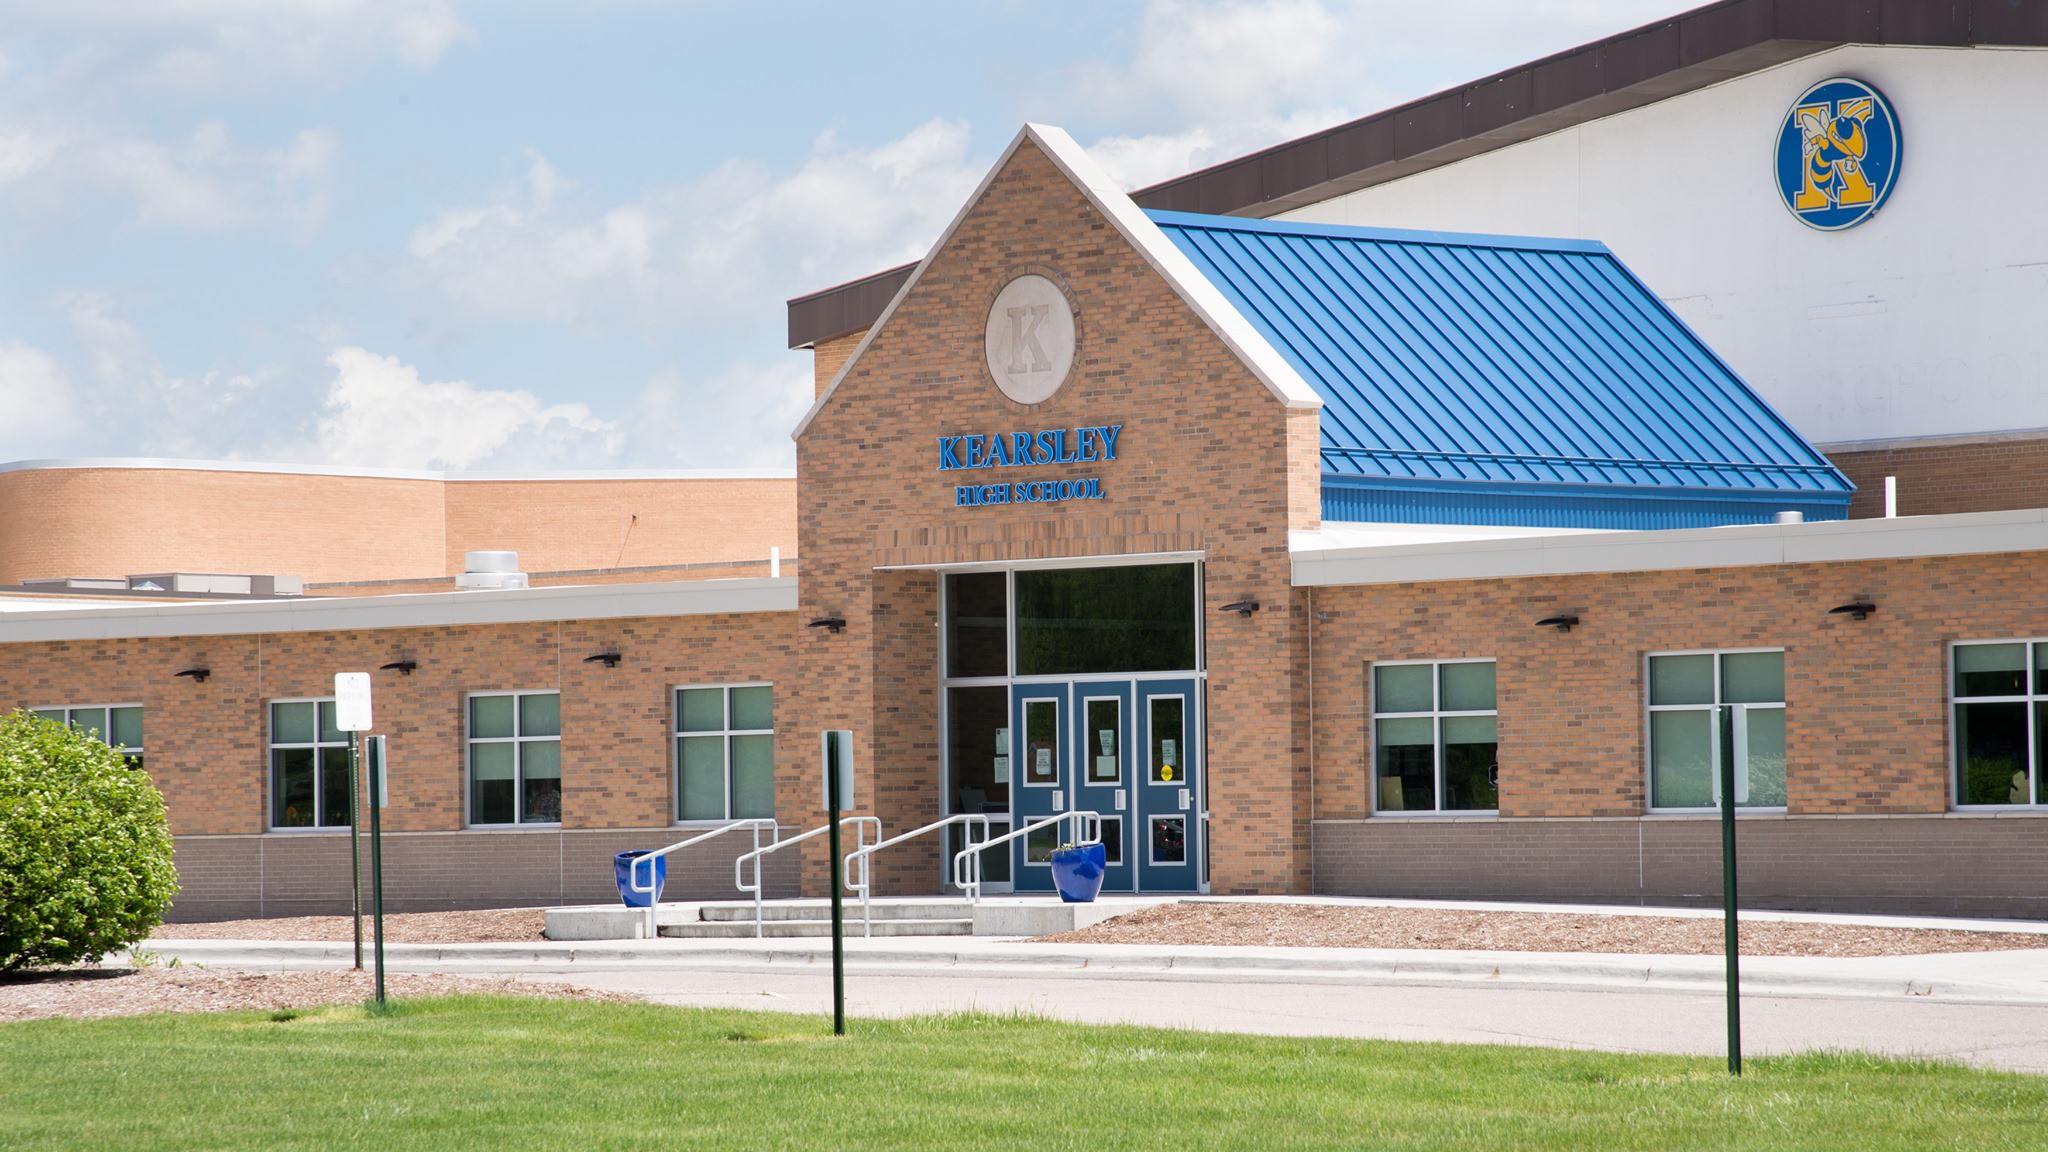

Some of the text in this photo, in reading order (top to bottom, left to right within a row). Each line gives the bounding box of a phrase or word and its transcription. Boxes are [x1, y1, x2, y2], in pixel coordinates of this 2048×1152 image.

[1794, 96, 1876, 213] K
[1007, 304, 1052, 374] K
[936, 425, 1122, 471] KEARSLEY
[954, 478, 1106, 507] HIGH SCHOOL
[346, 679, 359, 689] NO
